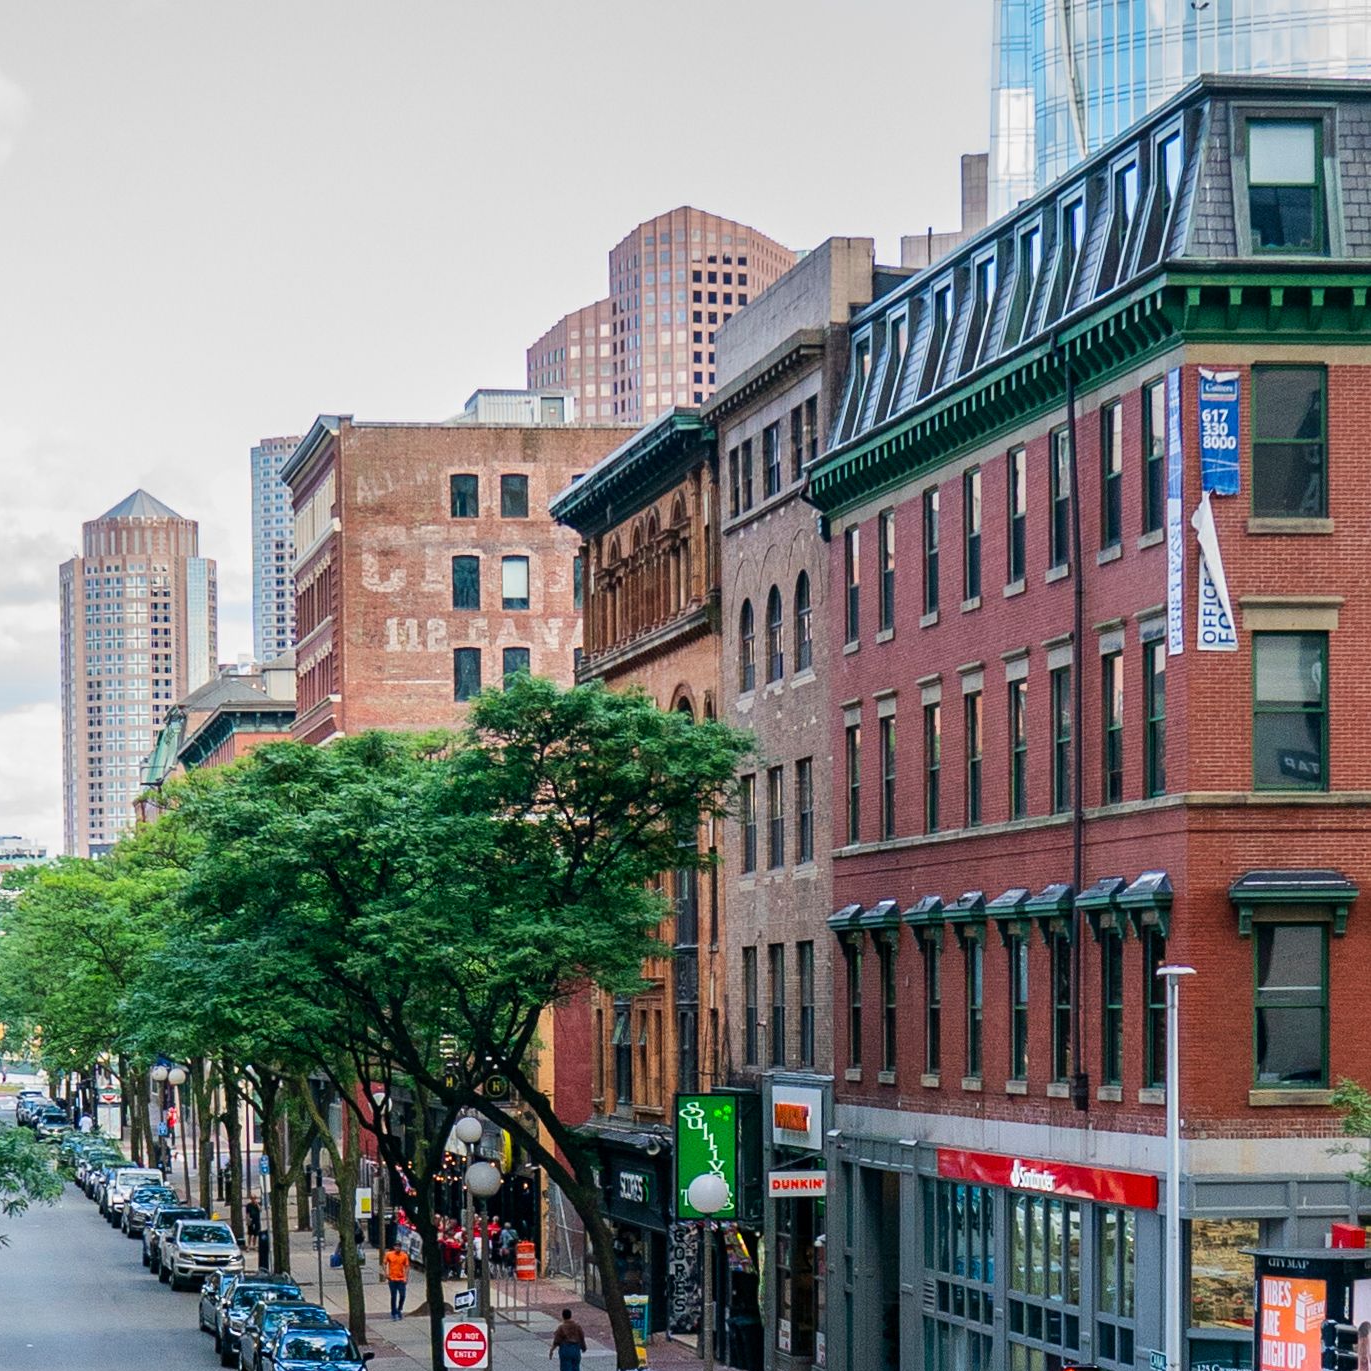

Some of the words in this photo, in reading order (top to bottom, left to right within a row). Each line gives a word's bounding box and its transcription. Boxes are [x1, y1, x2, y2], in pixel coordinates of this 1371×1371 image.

[1202, 409, 1229, 422] 617
[1203, 422, 1229, 436] 330
[1203, 435, 1237, 450] 8000
[772, 1178, 825, 1190] DUNKIN'
[1268, 1257, 1286, 1269] CITY
[1287, 1259, 1310, 1270] MAP
[1262, 1278, 1292, 1308] VIBES
[1263, 1309, 1281, 1337] ARE
[451, 1332, 462, 1340] DO
[464, 1332, 480, 1340] NOT
[453, 1350, 478, 1359] ENTER
[1262, 1340, 1286, 1369] HIGH
[1287, 1342, 1307, 1370] UP
